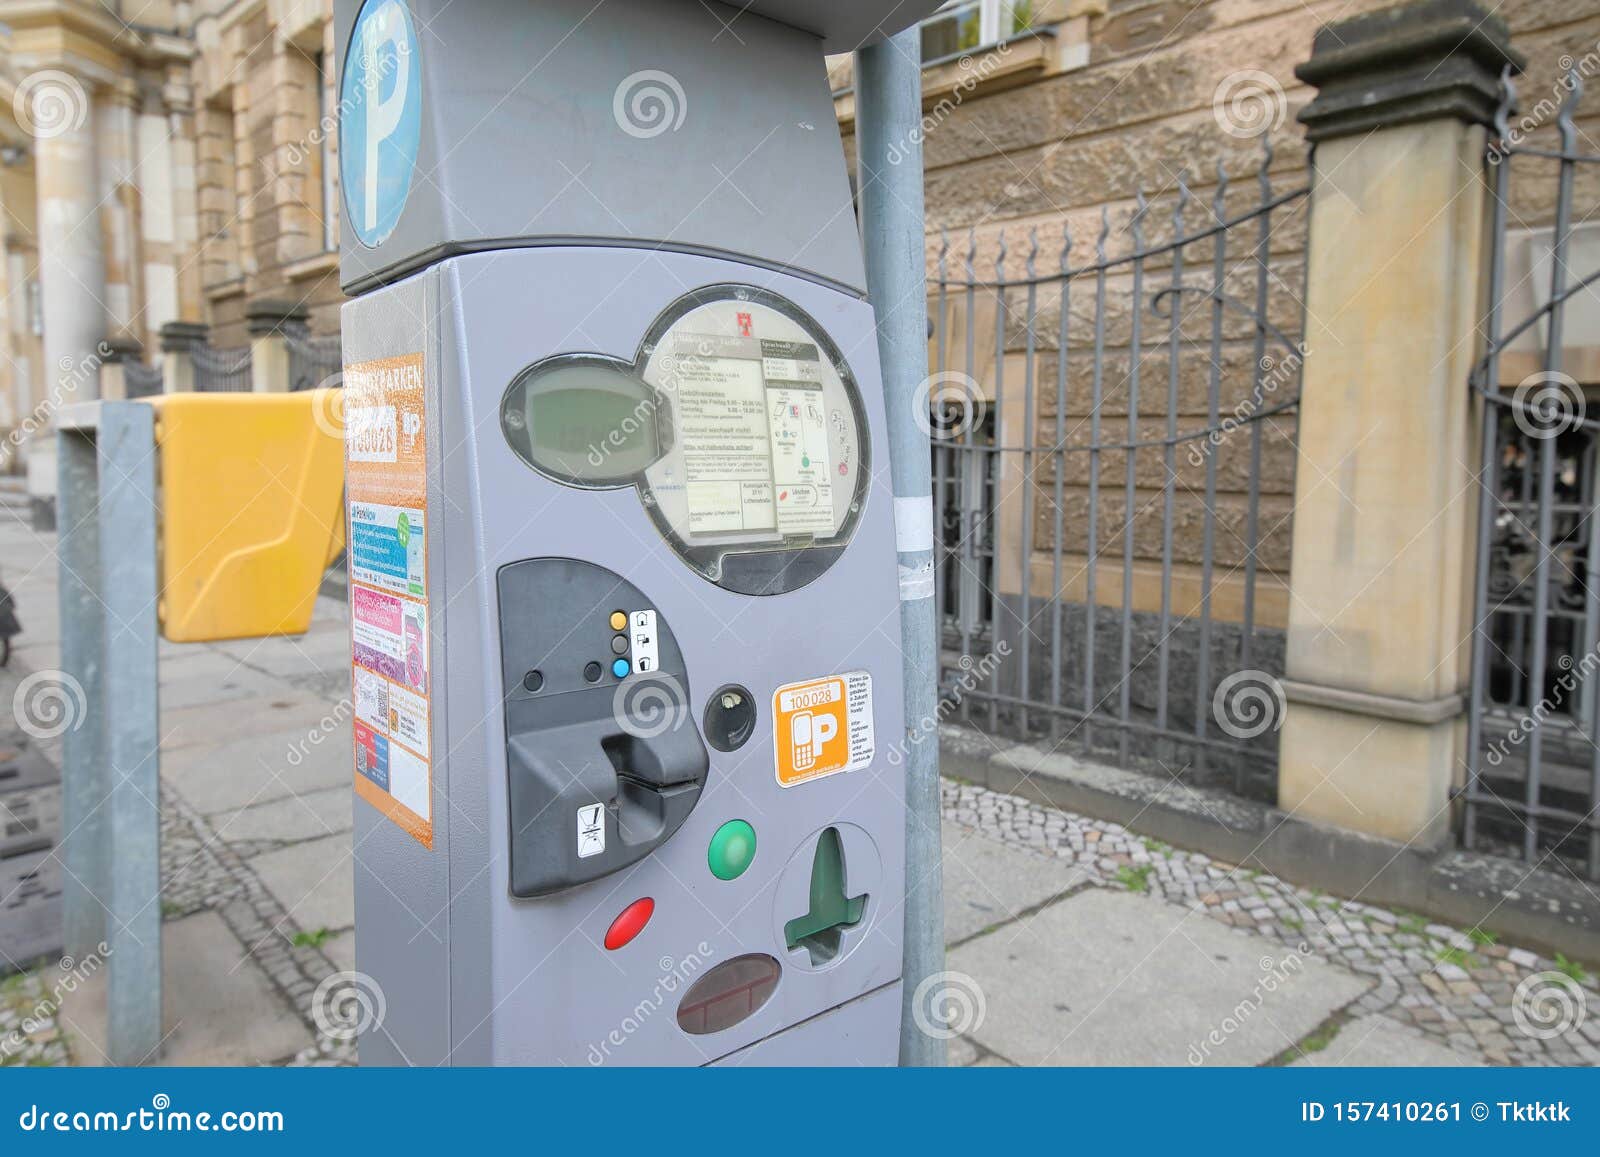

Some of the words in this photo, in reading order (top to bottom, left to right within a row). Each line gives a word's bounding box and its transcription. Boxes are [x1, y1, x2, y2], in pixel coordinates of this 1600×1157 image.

[362, 1, 409, 231] P
[790, 694, 810, 709] 100
[811, 689, 832, 705] 028
[812, 713, 838, 757] P
